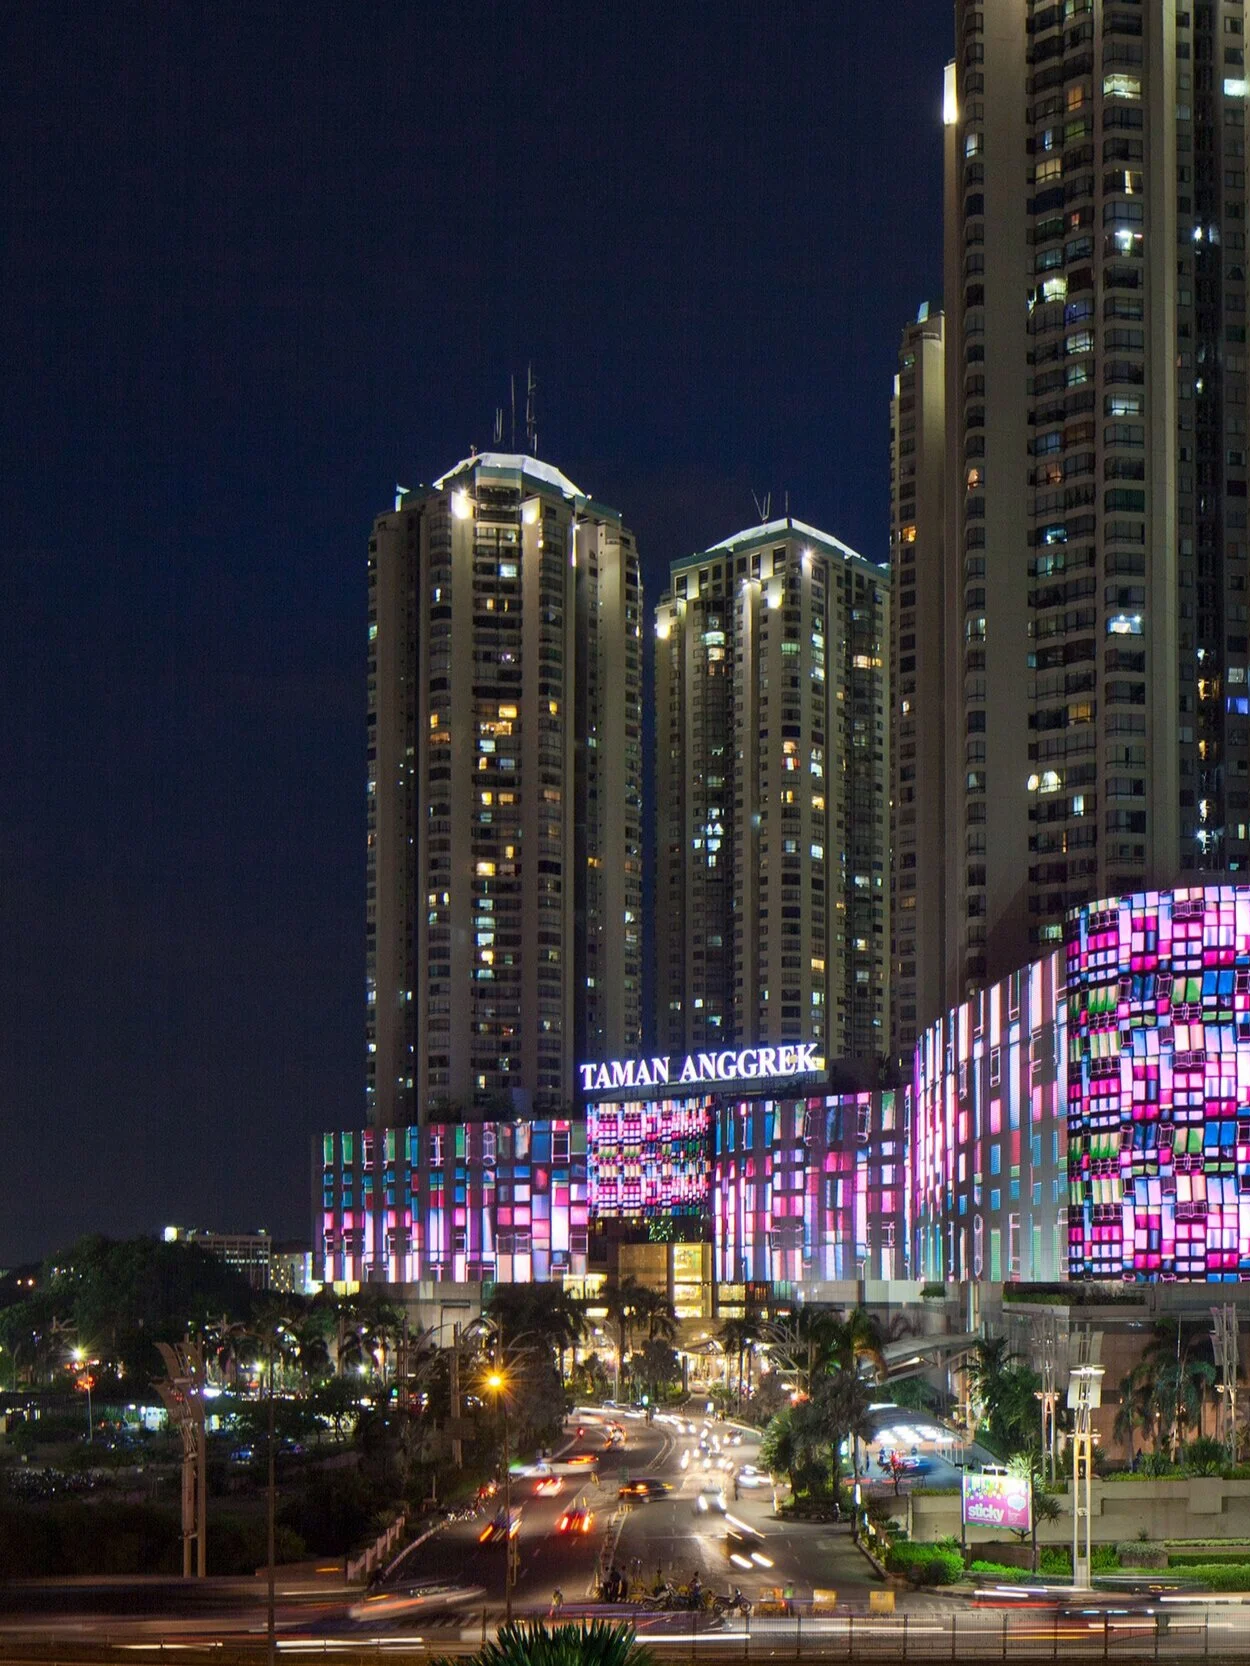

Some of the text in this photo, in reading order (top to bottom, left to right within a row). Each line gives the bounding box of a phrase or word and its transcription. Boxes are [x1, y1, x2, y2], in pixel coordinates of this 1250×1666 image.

[580, 1043, 818, 1090] TAMAN ANGGREK
[968, 1503, 1004, 1522] sticky
